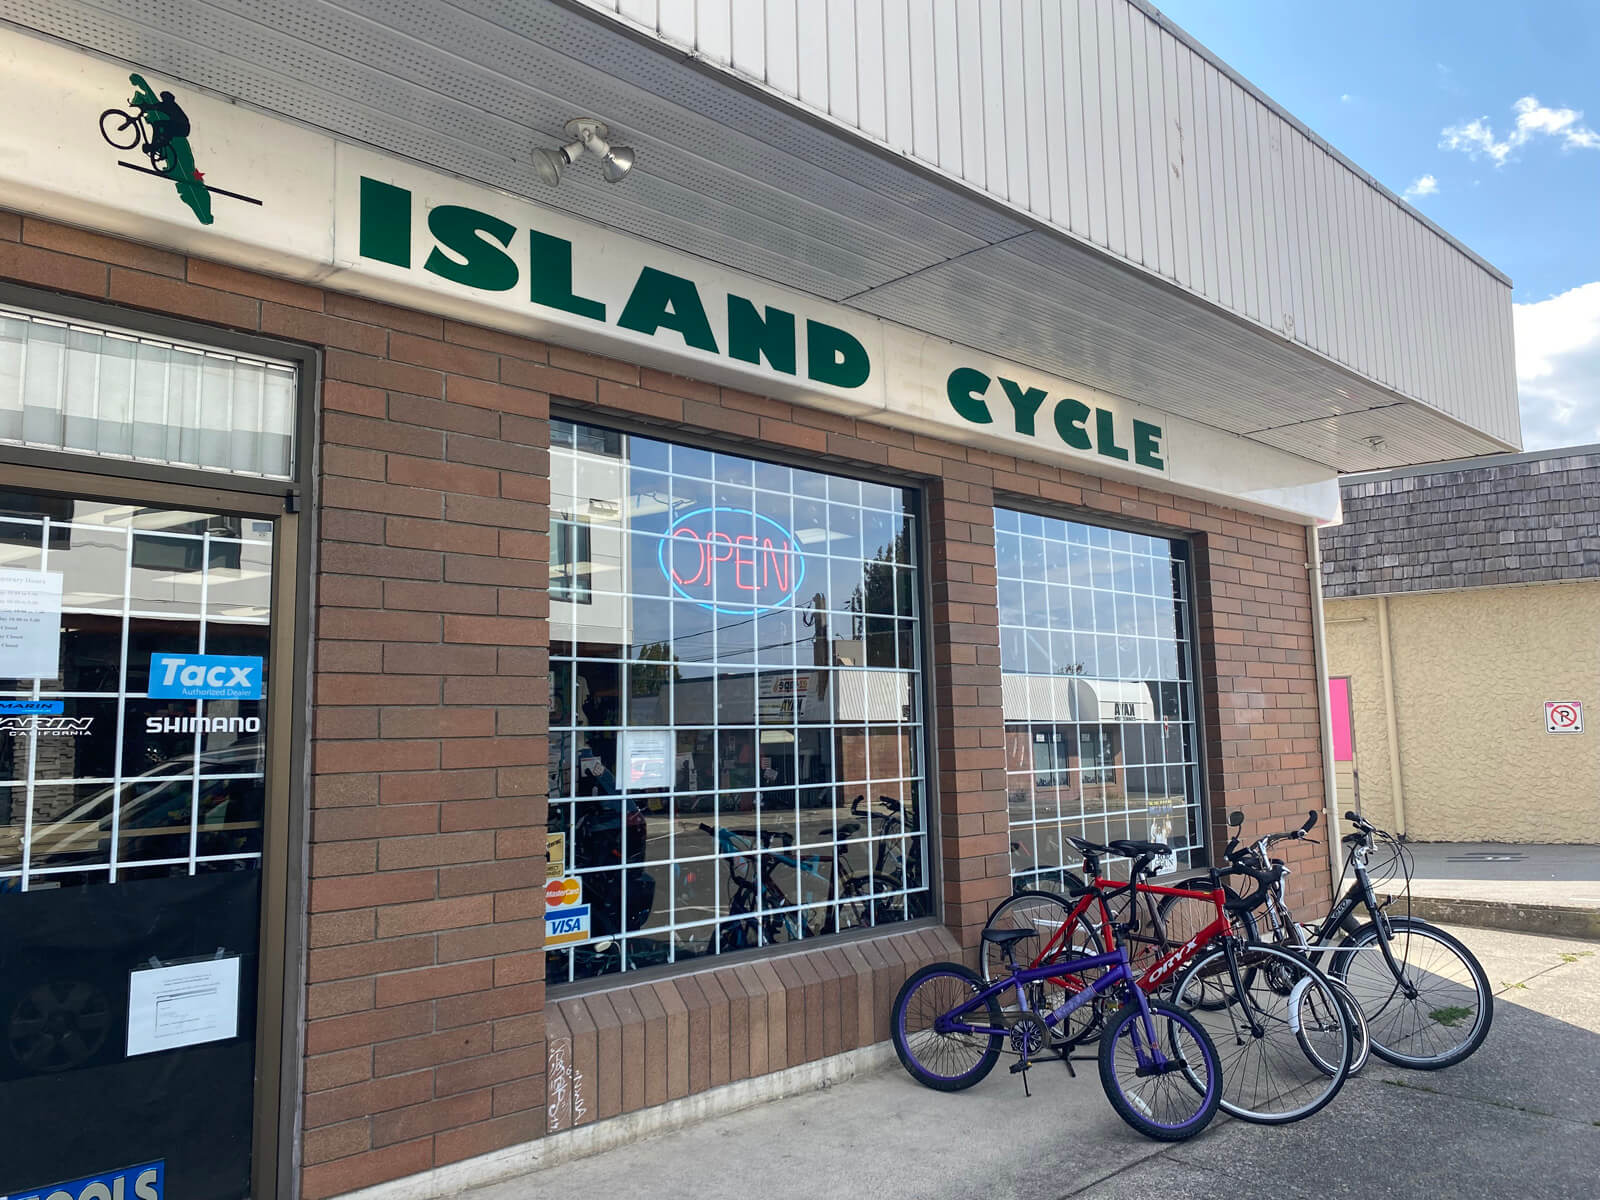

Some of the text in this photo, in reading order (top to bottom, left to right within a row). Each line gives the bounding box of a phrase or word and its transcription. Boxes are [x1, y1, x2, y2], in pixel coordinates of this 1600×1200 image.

[360, 175, 1164, 471] ISLAND CYCLE
[671, 528, 788, 592] OPEN
[161, 658, 254, 688] Tacx
[182, 687, 252, 697] Authorized Dealer
[0, 717, 94, 731] ARIN
[146, 717, 260, 733] SHIMANO
[1560, 710, 1570, 722] P
[551, 918, 581, 940] VISA
[1149, 935, 1198, 982] ORYX
